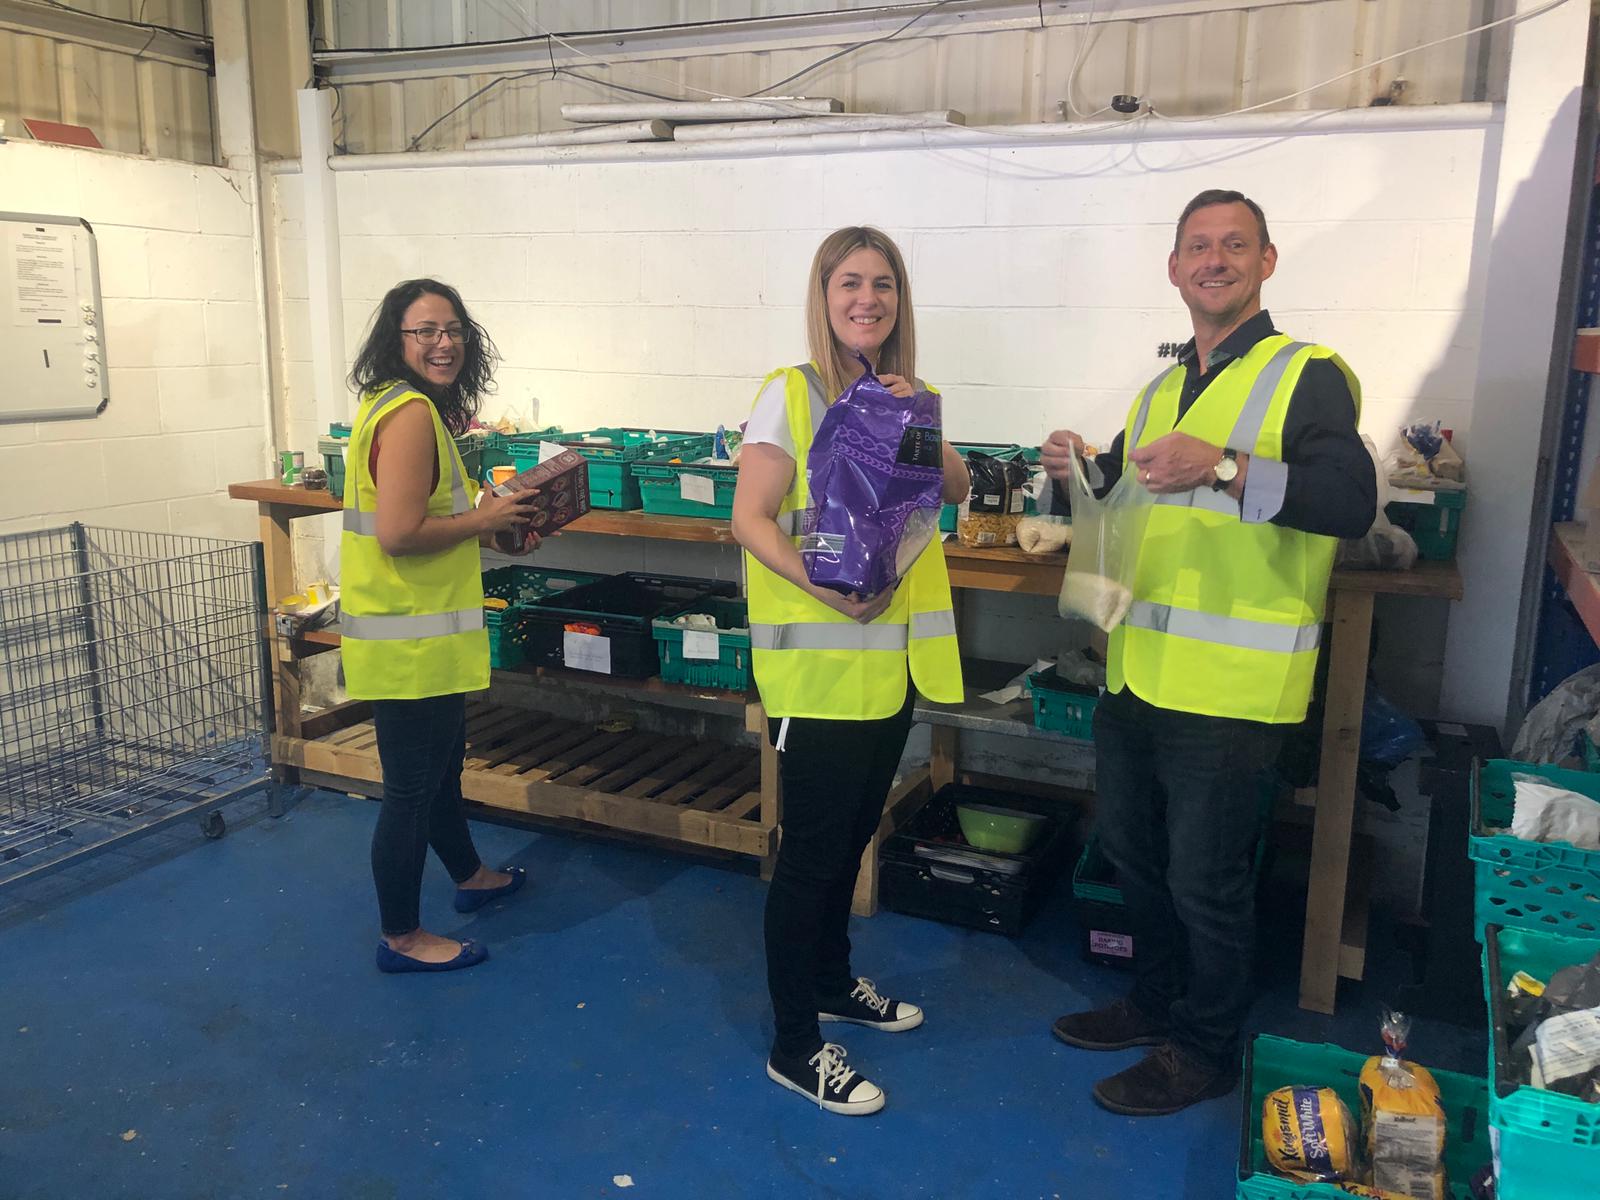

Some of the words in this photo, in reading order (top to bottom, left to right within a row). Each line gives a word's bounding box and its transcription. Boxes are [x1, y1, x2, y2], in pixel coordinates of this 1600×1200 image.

[1272, 1095, 1301, 1161] Kingsmill
[1300, 1097, 1316, 1131] White
[1302, 1130, 1324, 1159] Soft
